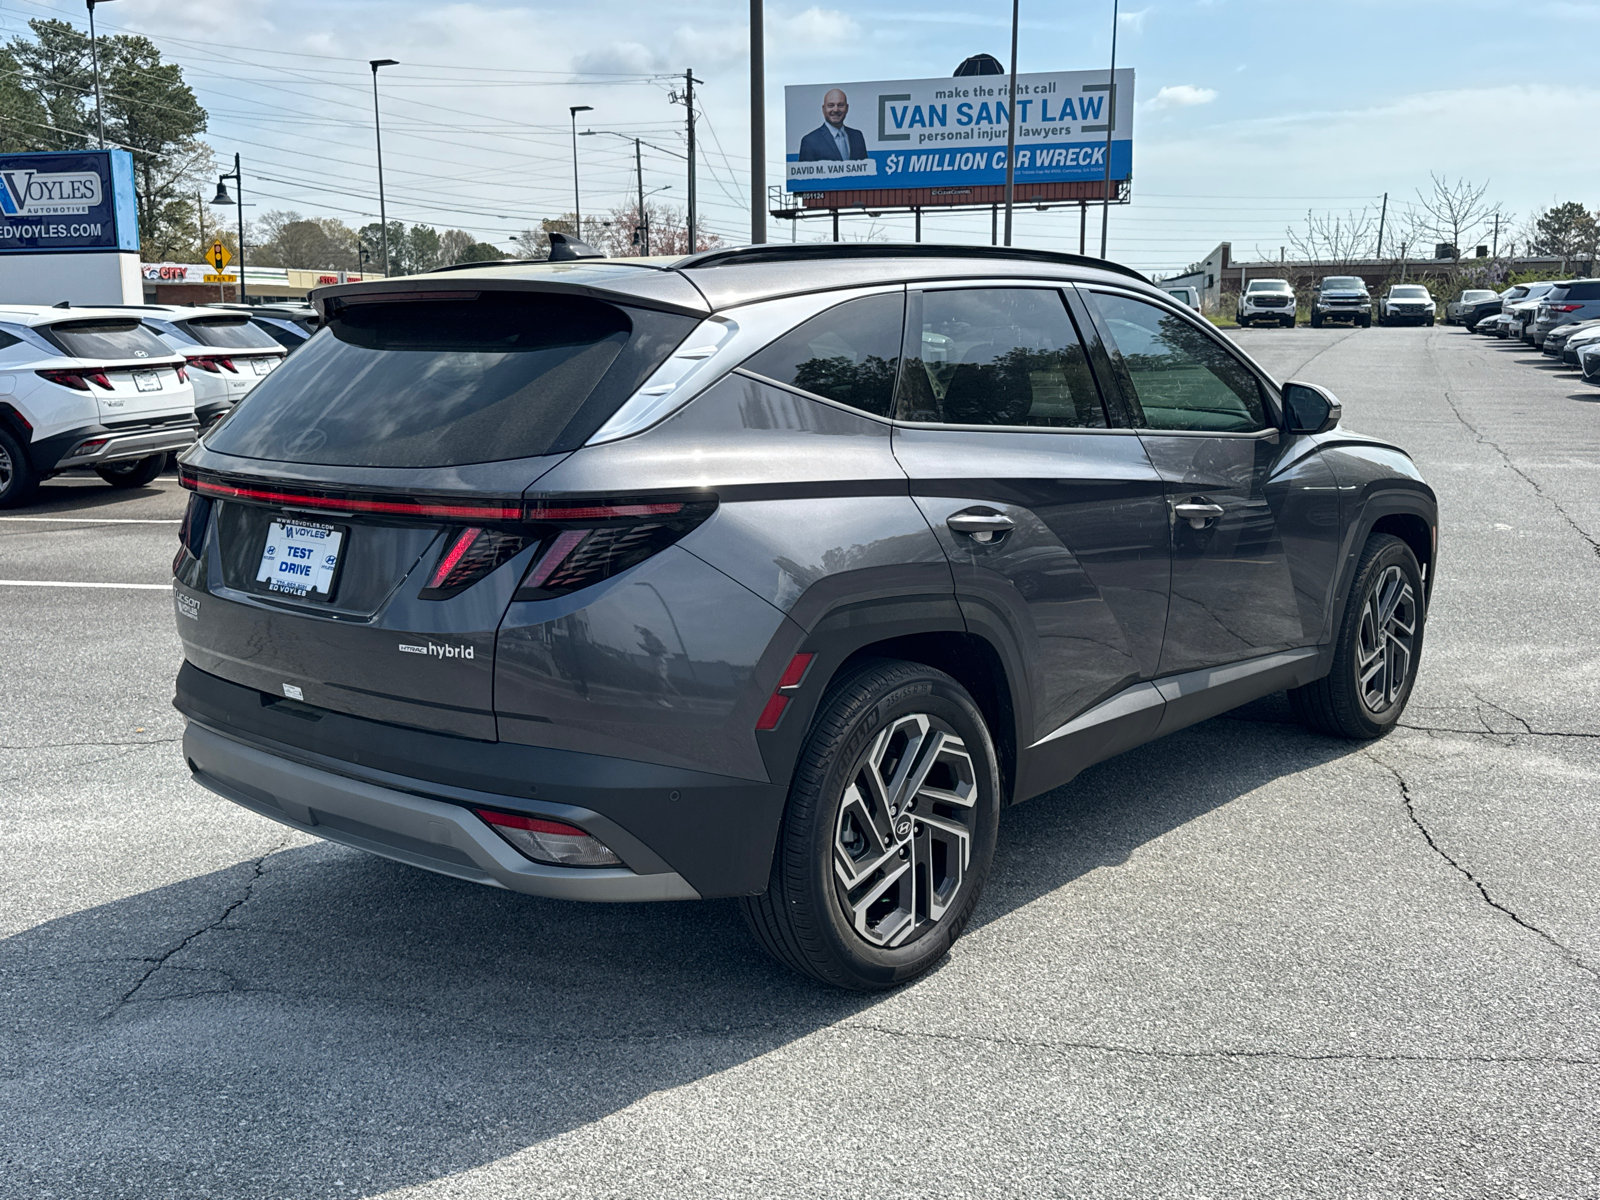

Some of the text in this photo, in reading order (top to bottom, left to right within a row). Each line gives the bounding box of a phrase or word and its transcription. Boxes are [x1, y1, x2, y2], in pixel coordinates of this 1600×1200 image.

[935, 82, 1056, 99] make the riht call
[890, 96, 1104, 129] VAN SANT LAW
[919, 125, 1071, 144] personal injur lawyers
[885, 154, 904, 175] $1
[908, 152, 988, 172] MILLION
[1035, 147, 1106, 167] WRECK
[791, 164, 868, 176] DAVID M. VAN SANT
[3, 172, 94, 210] VOYLES
[159, 267, 188, 279] CITY
[295, 527, 326, 539] VOYLES
[287, 546, 314, 560] TEST
[279, 561, 312, 577] DRIVE
[269, 583, 279, 591] ED
[280, 585, 307, 597] VOYLES
[428, 641, 475, 660] hybrid
[828, 710, 879, 804] MICHELIN
